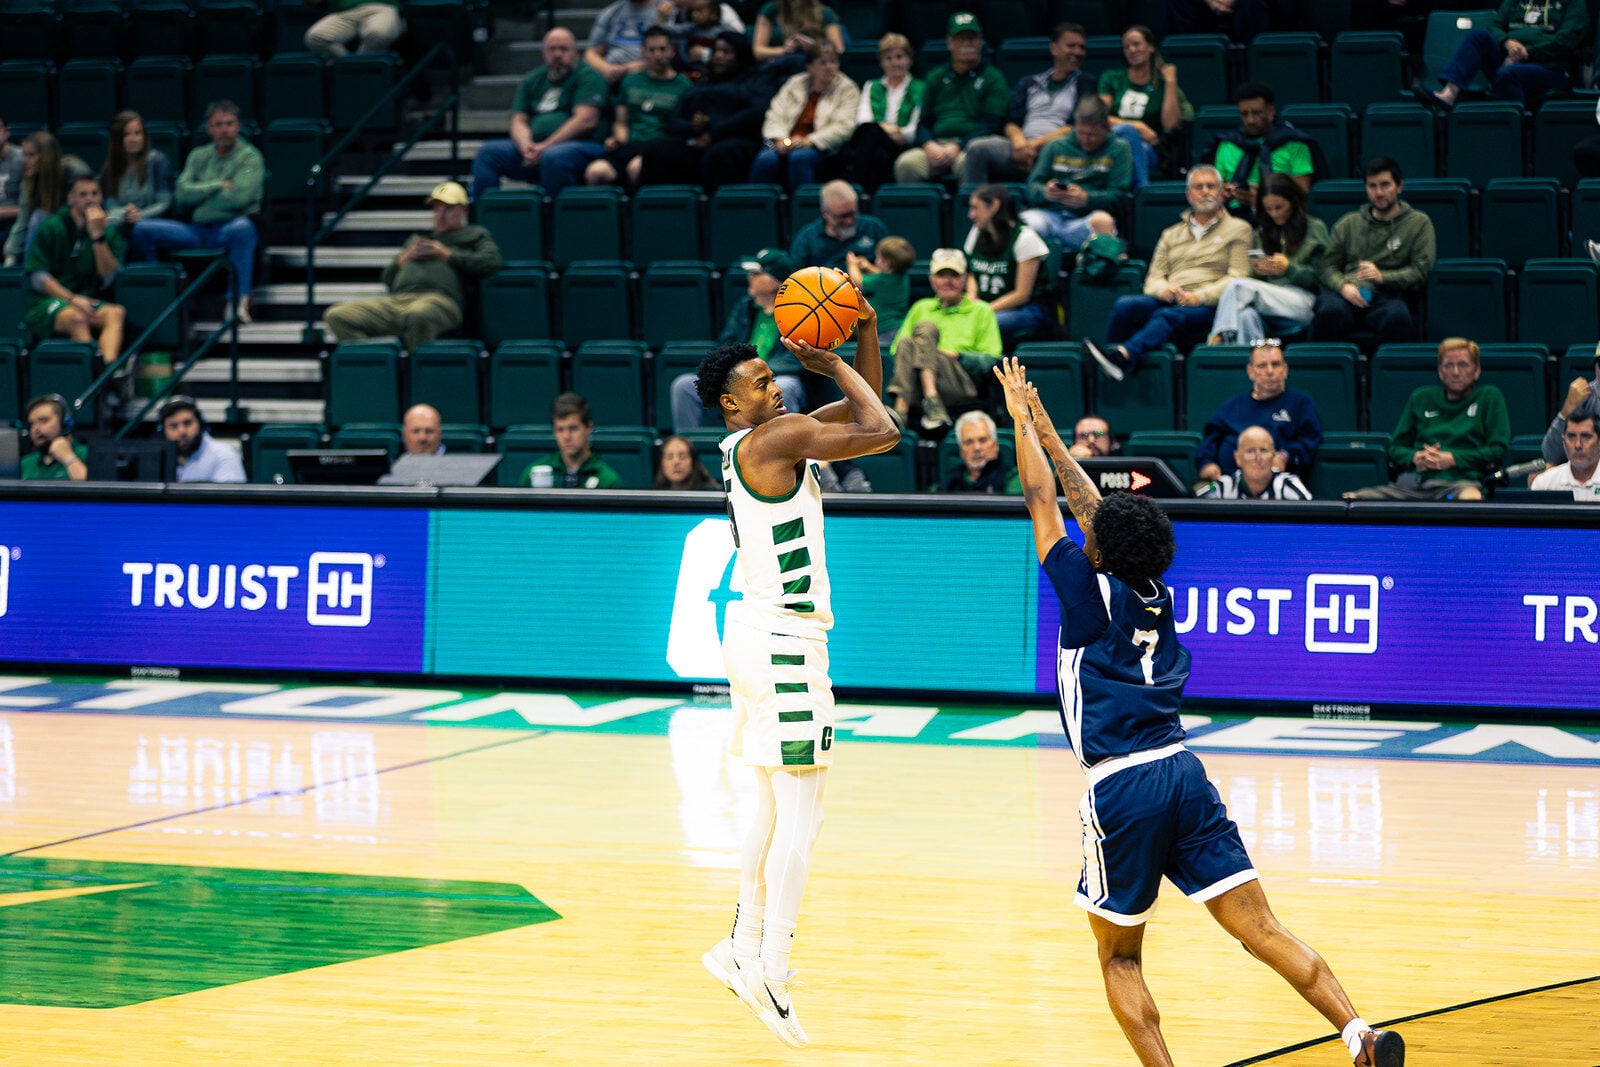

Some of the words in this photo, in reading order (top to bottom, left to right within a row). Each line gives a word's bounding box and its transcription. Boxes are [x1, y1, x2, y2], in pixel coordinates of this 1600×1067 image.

[1100, 472, 1130, 489] POSS
[122, 562, 300, 610] TRUIST
[1523, 594, 1599, 644] TR
[1131, 628, 1159, 686] 7
